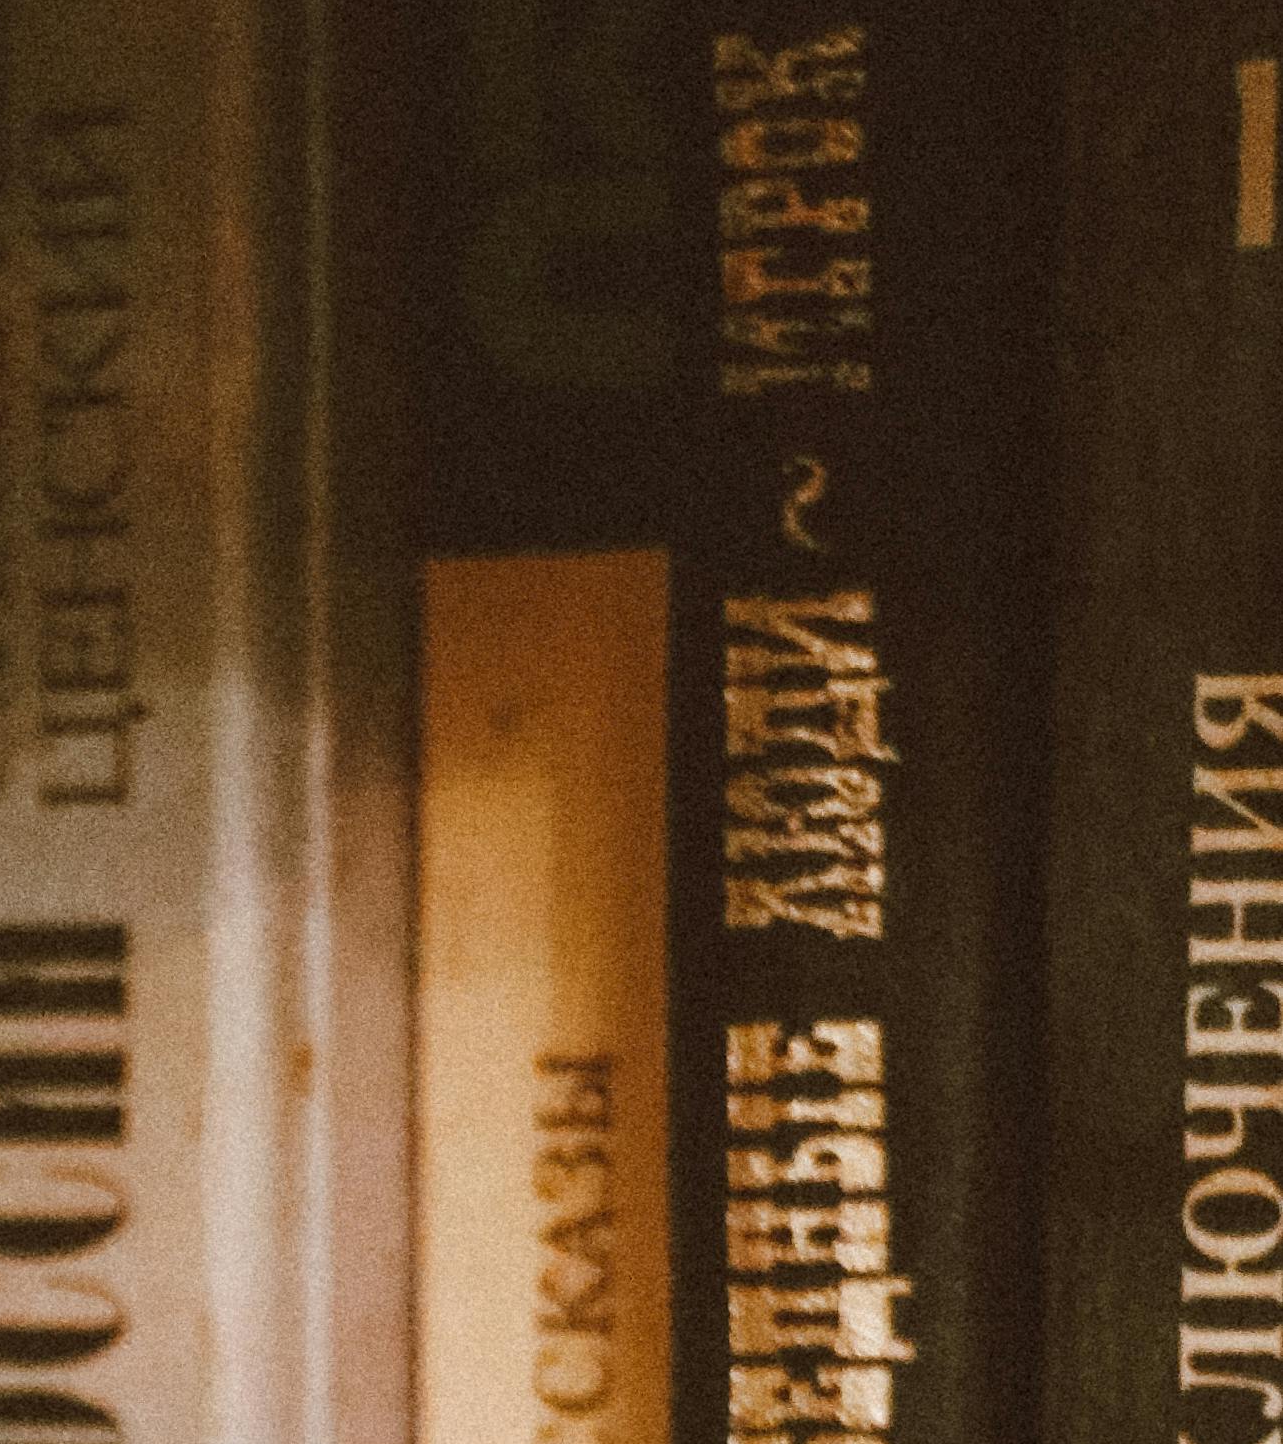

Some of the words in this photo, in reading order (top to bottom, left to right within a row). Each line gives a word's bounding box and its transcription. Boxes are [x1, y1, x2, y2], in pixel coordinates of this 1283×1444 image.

[712, 24, 873, 399] ИГРОК
[33, 102, 147, 810] ЦЕНСКИЙ
[723, 587, 900, 942] ЛЮДИ
